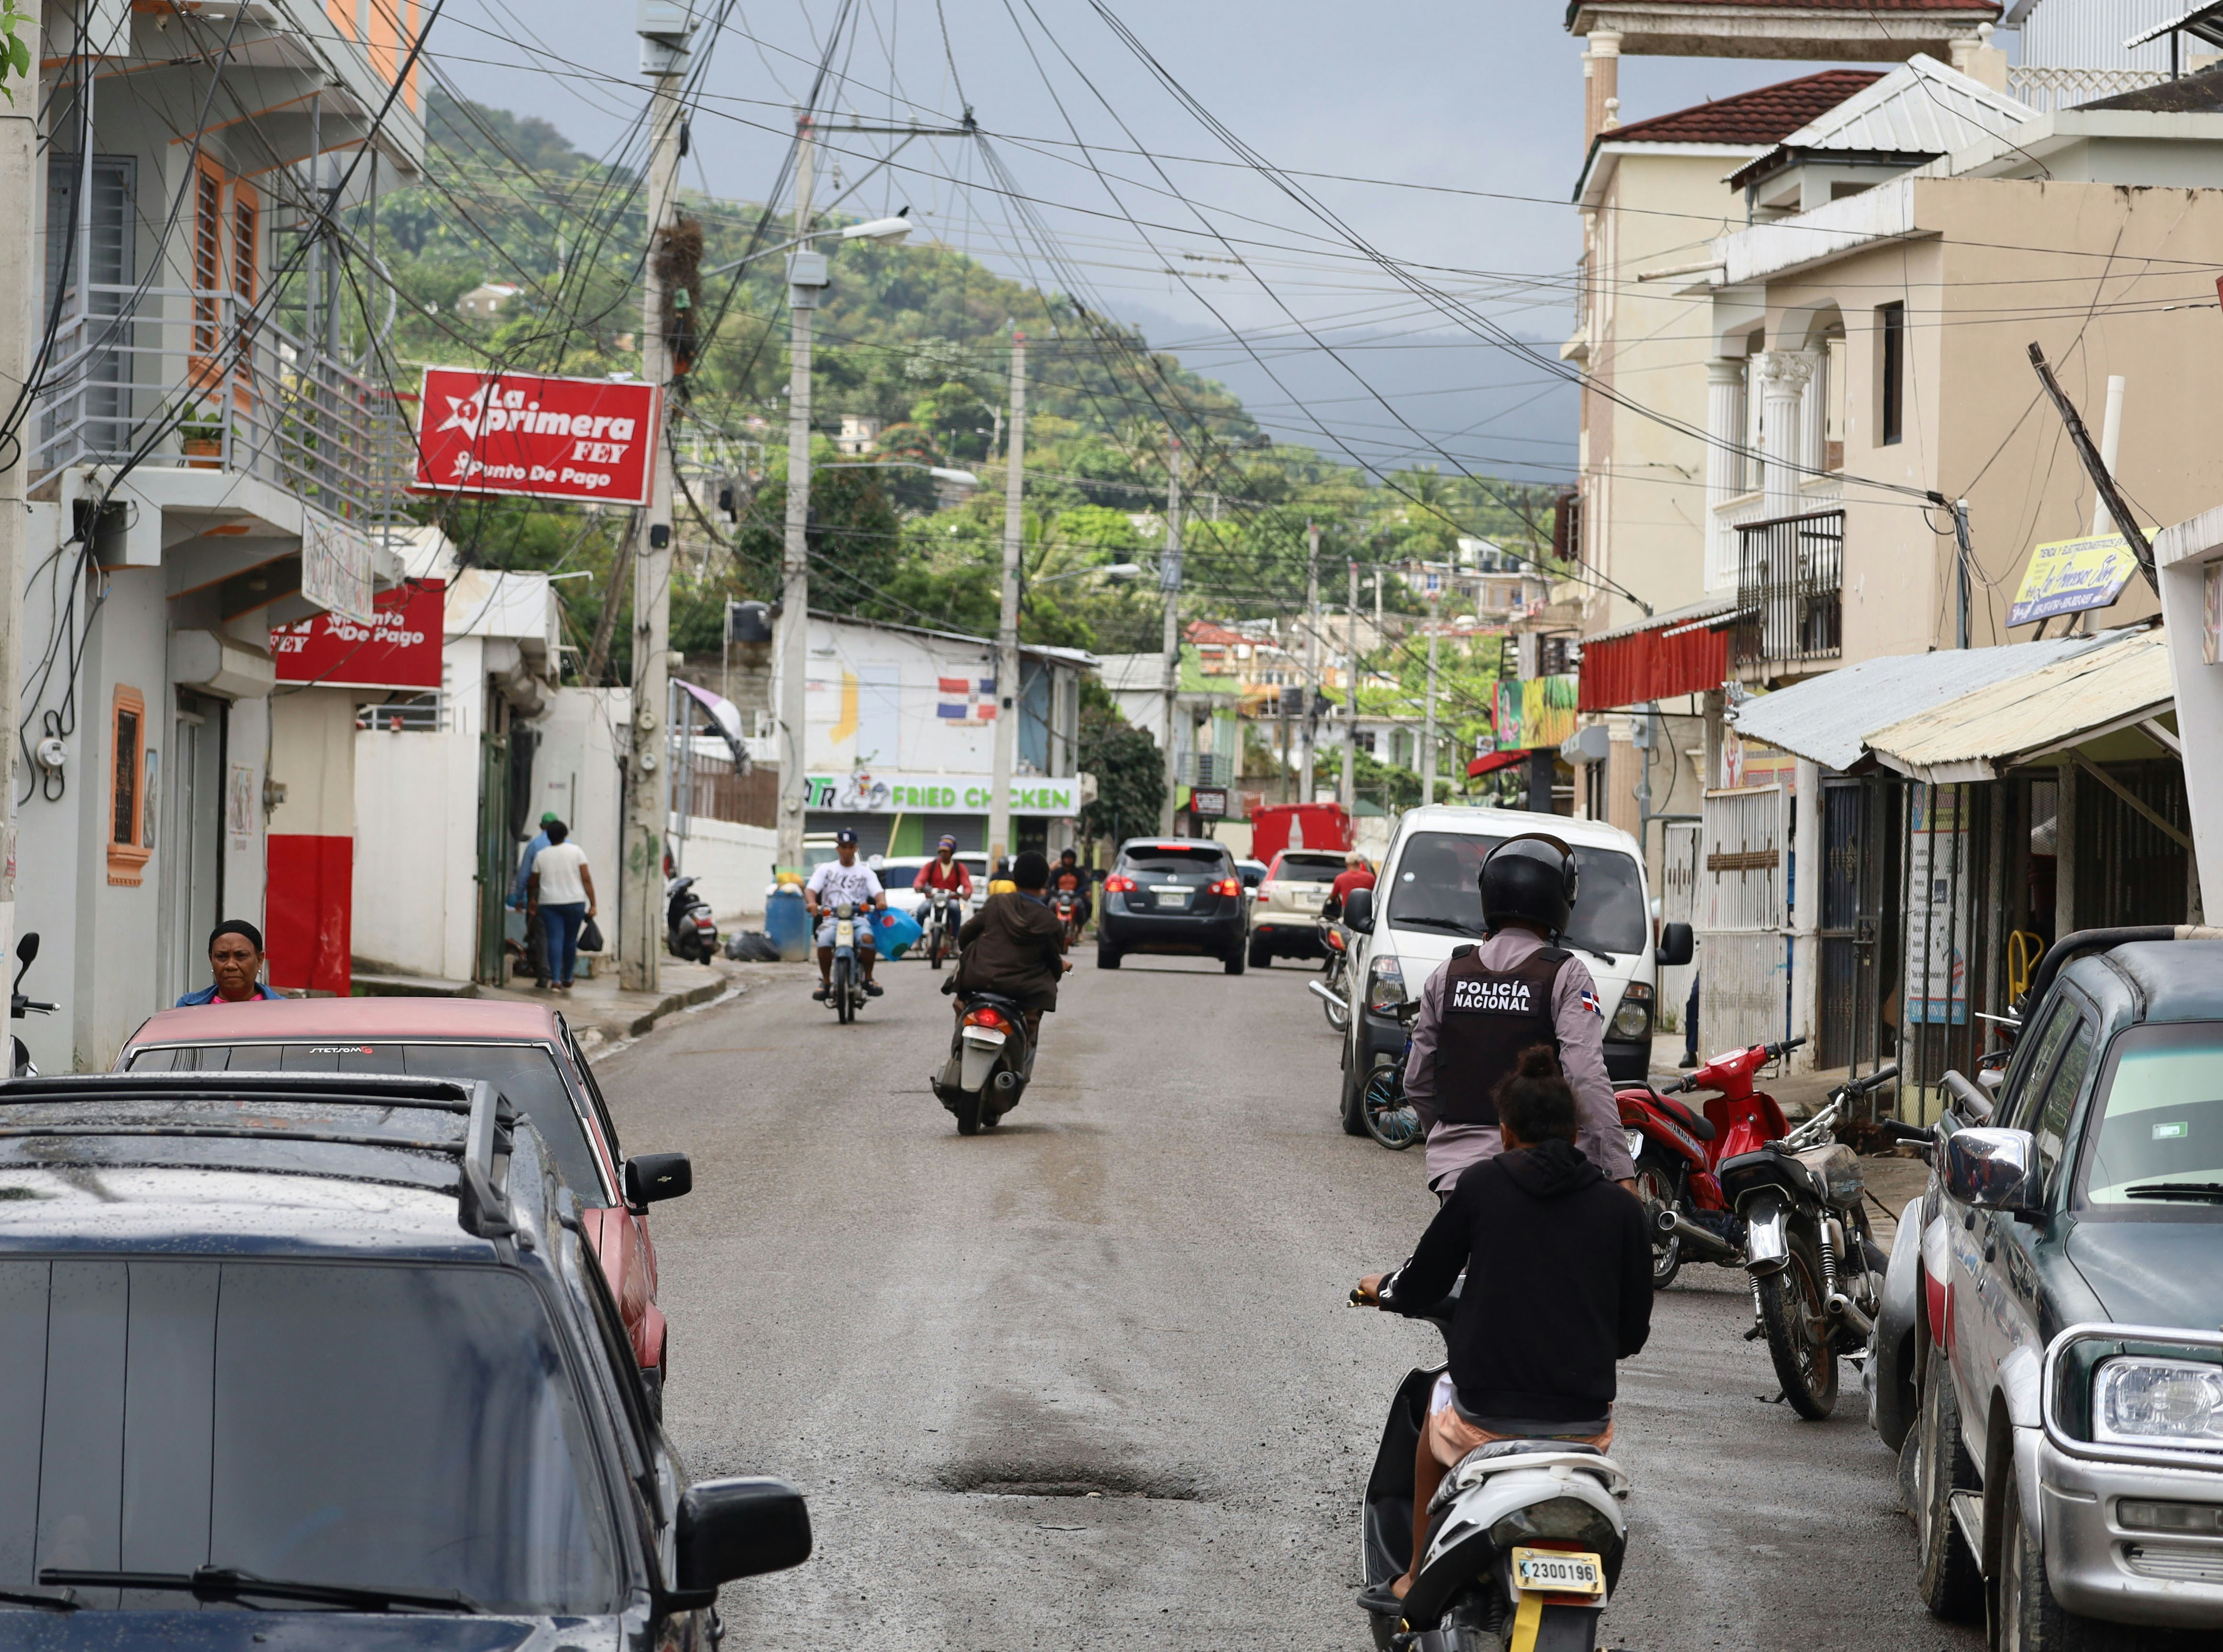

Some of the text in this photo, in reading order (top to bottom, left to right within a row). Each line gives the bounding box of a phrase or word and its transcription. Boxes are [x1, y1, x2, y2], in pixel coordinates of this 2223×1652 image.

[488, 383, 526, 409] La
[479, 402, 636, 441] primera
[570, 440, 630, 464] FEY
[470, 459, 611, 489] Punto De Pago
[343, 625, 425, 647] De Pago
[892, 786, 956, 806] FRIED
[965, 787, 1070, 808] CHCKEN
[1455, 980, 1531, 998] POLICÍA
[1453, 993, 1530, 1011] NACIONAL
[1669, 1122, 1690, 1146] YAMAHA
